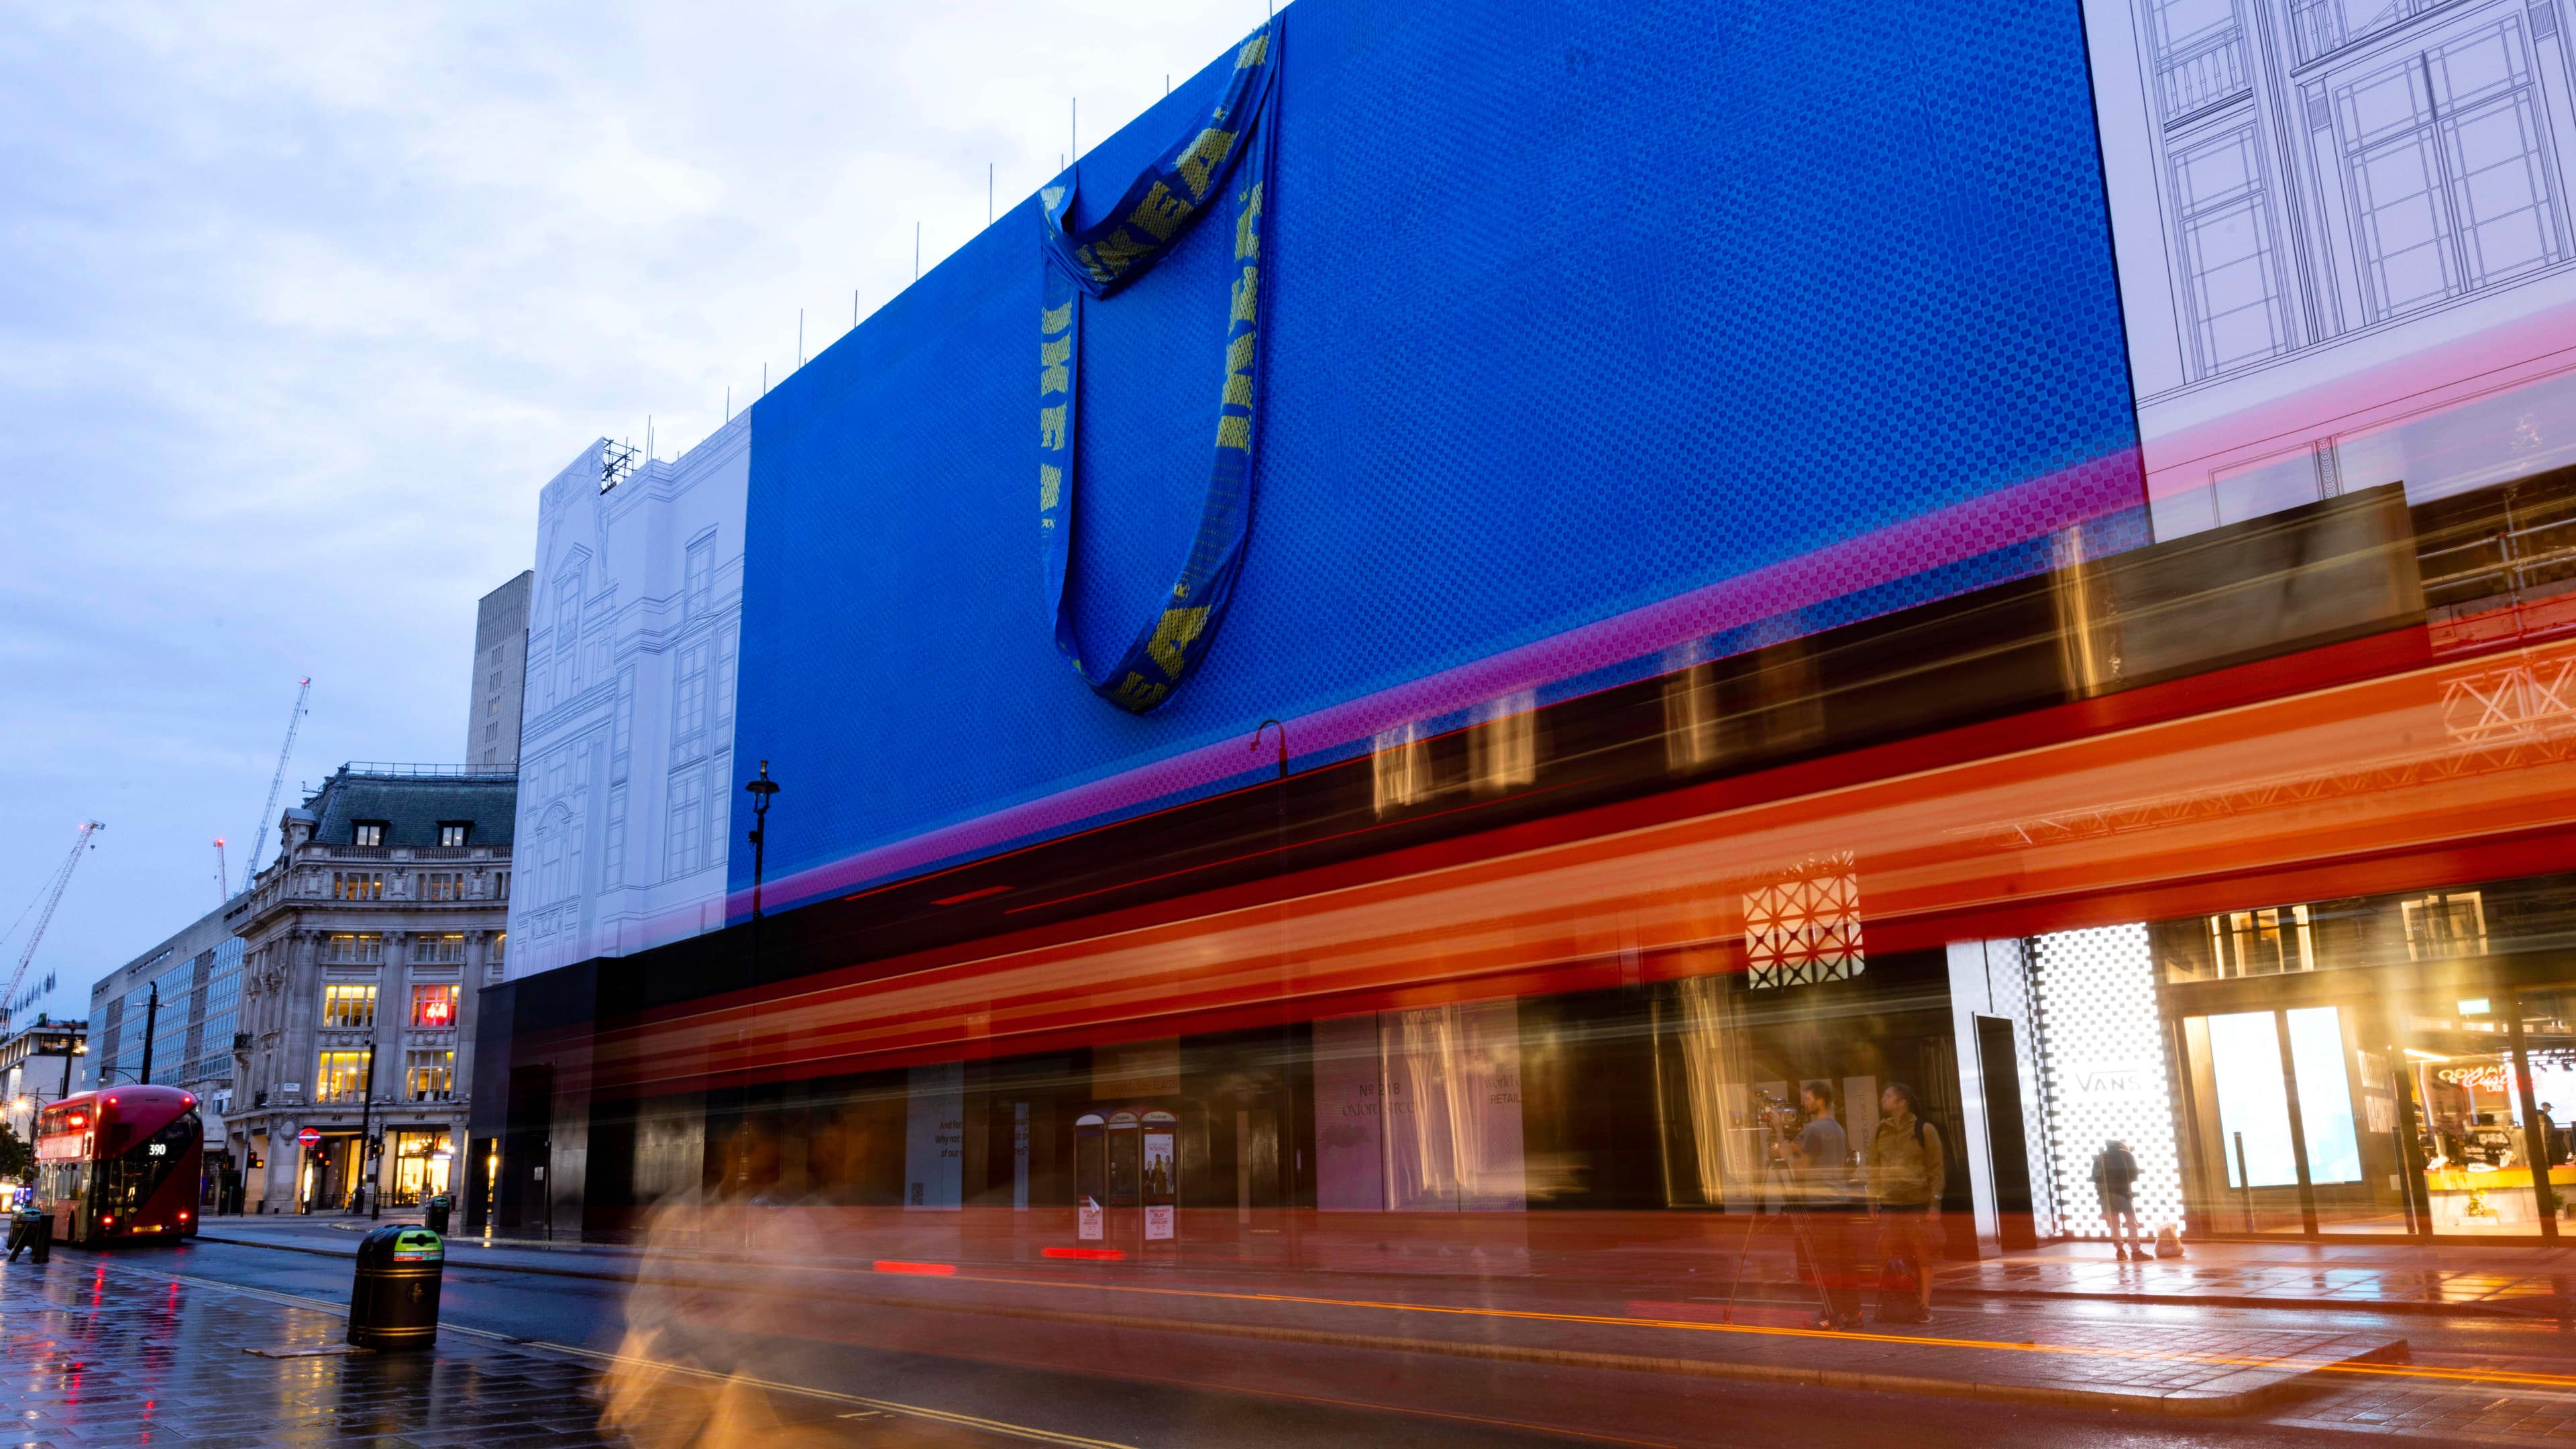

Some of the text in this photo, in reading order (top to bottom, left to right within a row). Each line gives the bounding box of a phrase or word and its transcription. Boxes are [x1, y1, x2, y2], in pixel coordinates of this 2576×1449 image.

[1076, 127, 1239, 282] IKEA
[2074, 1069, 2141, 1093] VANS
[1379, 1083, 1401, 1095] 218
[1491, 1093, 1521, 1104] RETAIL
[939, 1120, 951, 1130] And
[934, 1134, 960, 1146] Why not
[148, 1144, 166, 1156] 390
[941, 1148, 959, 1157] of our
